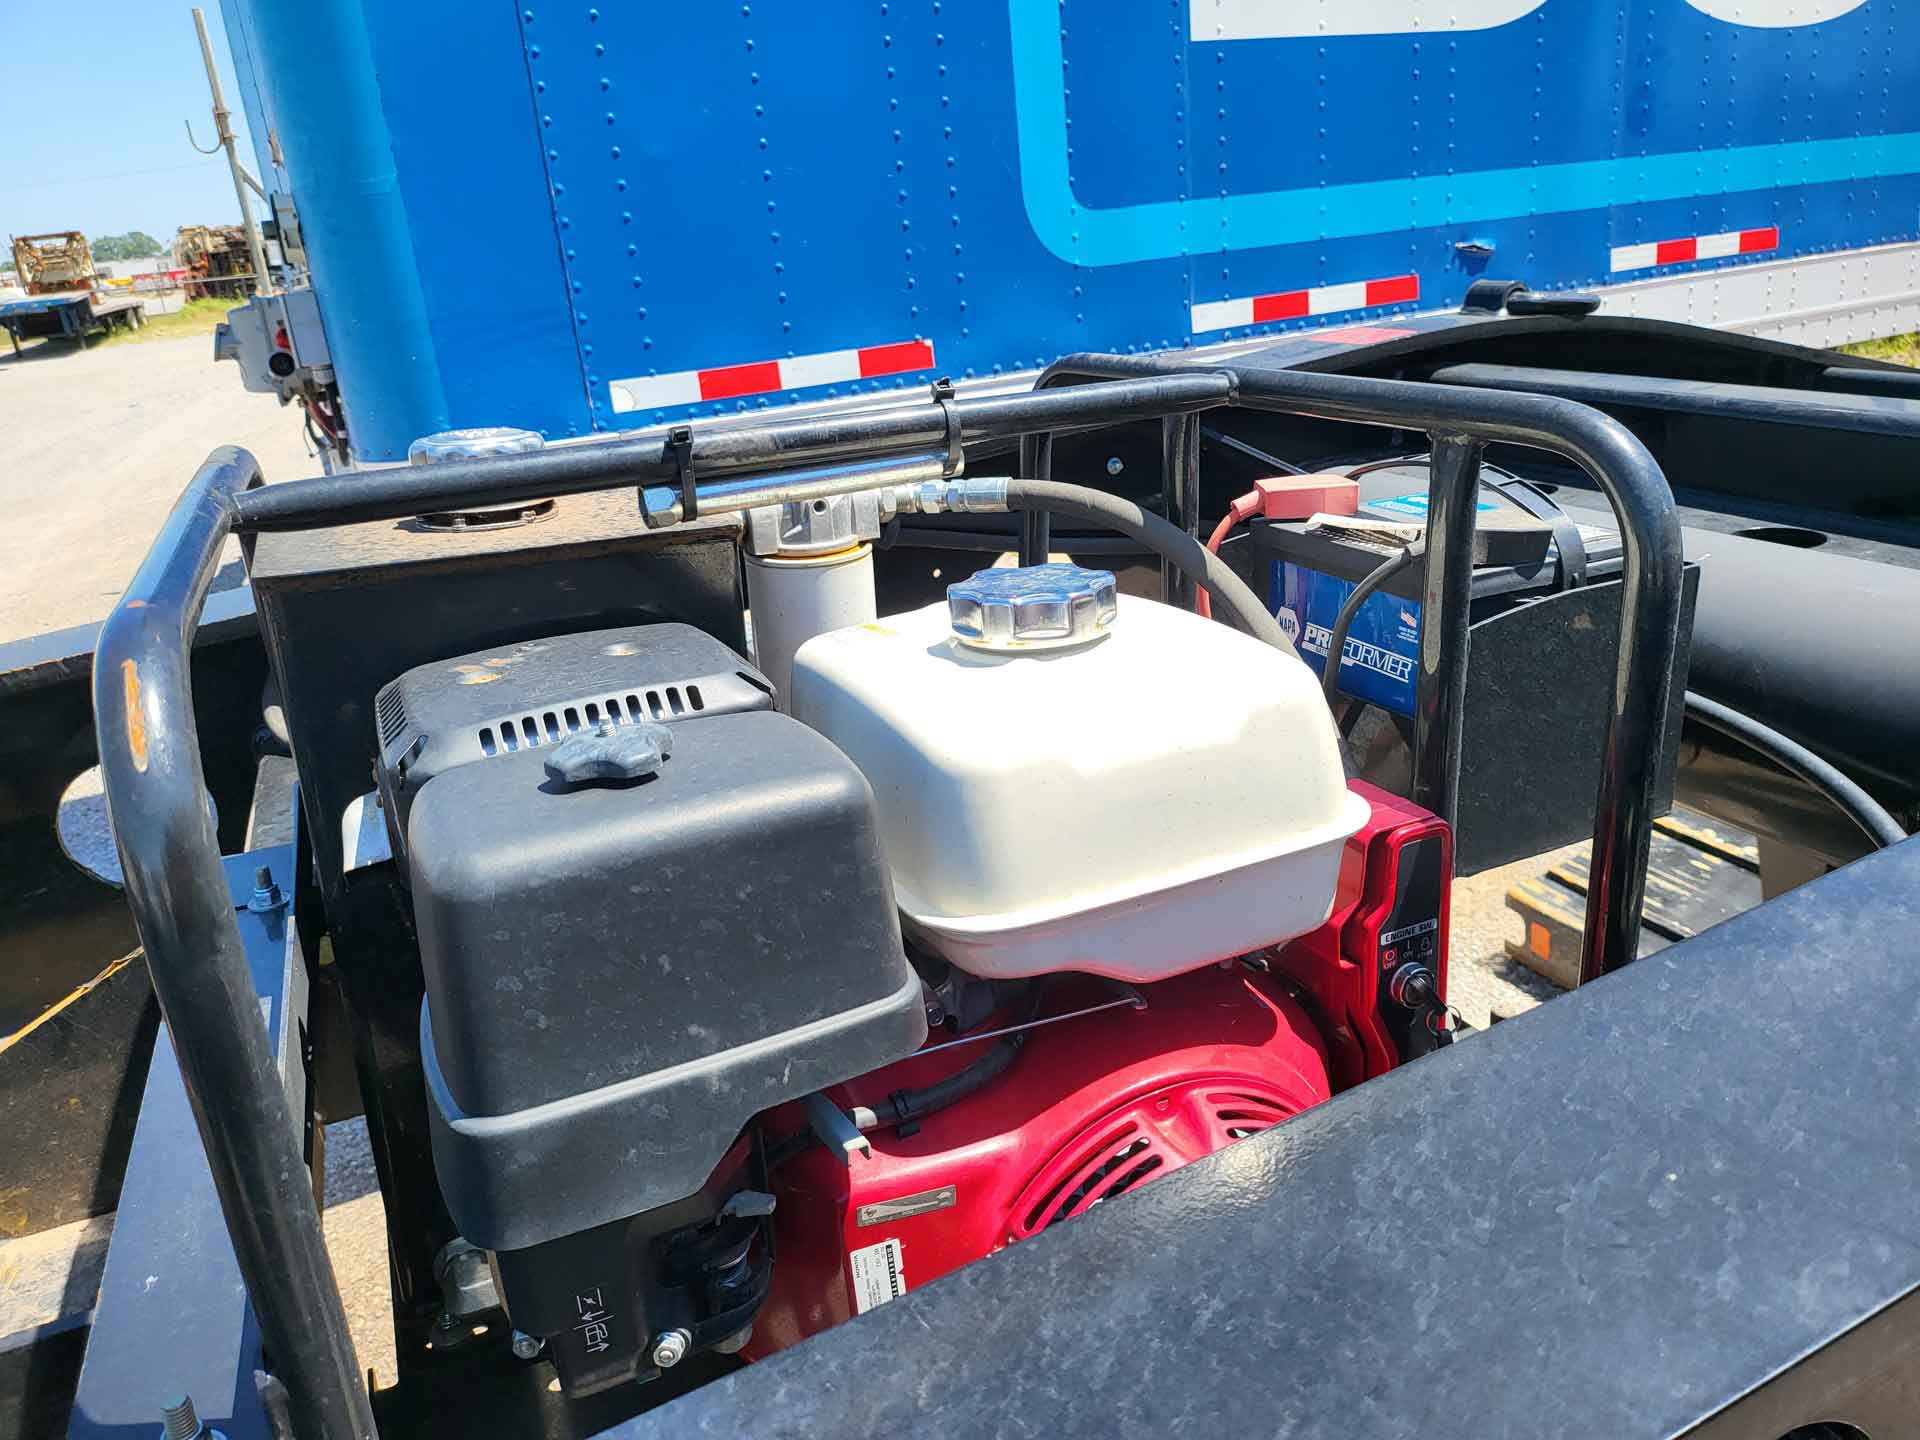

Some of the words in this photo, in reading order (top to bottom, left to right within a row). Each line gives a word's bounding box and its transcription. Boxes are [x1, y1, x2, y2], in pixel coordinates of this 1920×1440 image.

[1279, 615, 1296, 635] NAPA
[1304, 625, 1412, 680] PRFORMER
[1385, 927, 1417, 942] ENGINE
[1383, 960, 1397, 970] OFF
